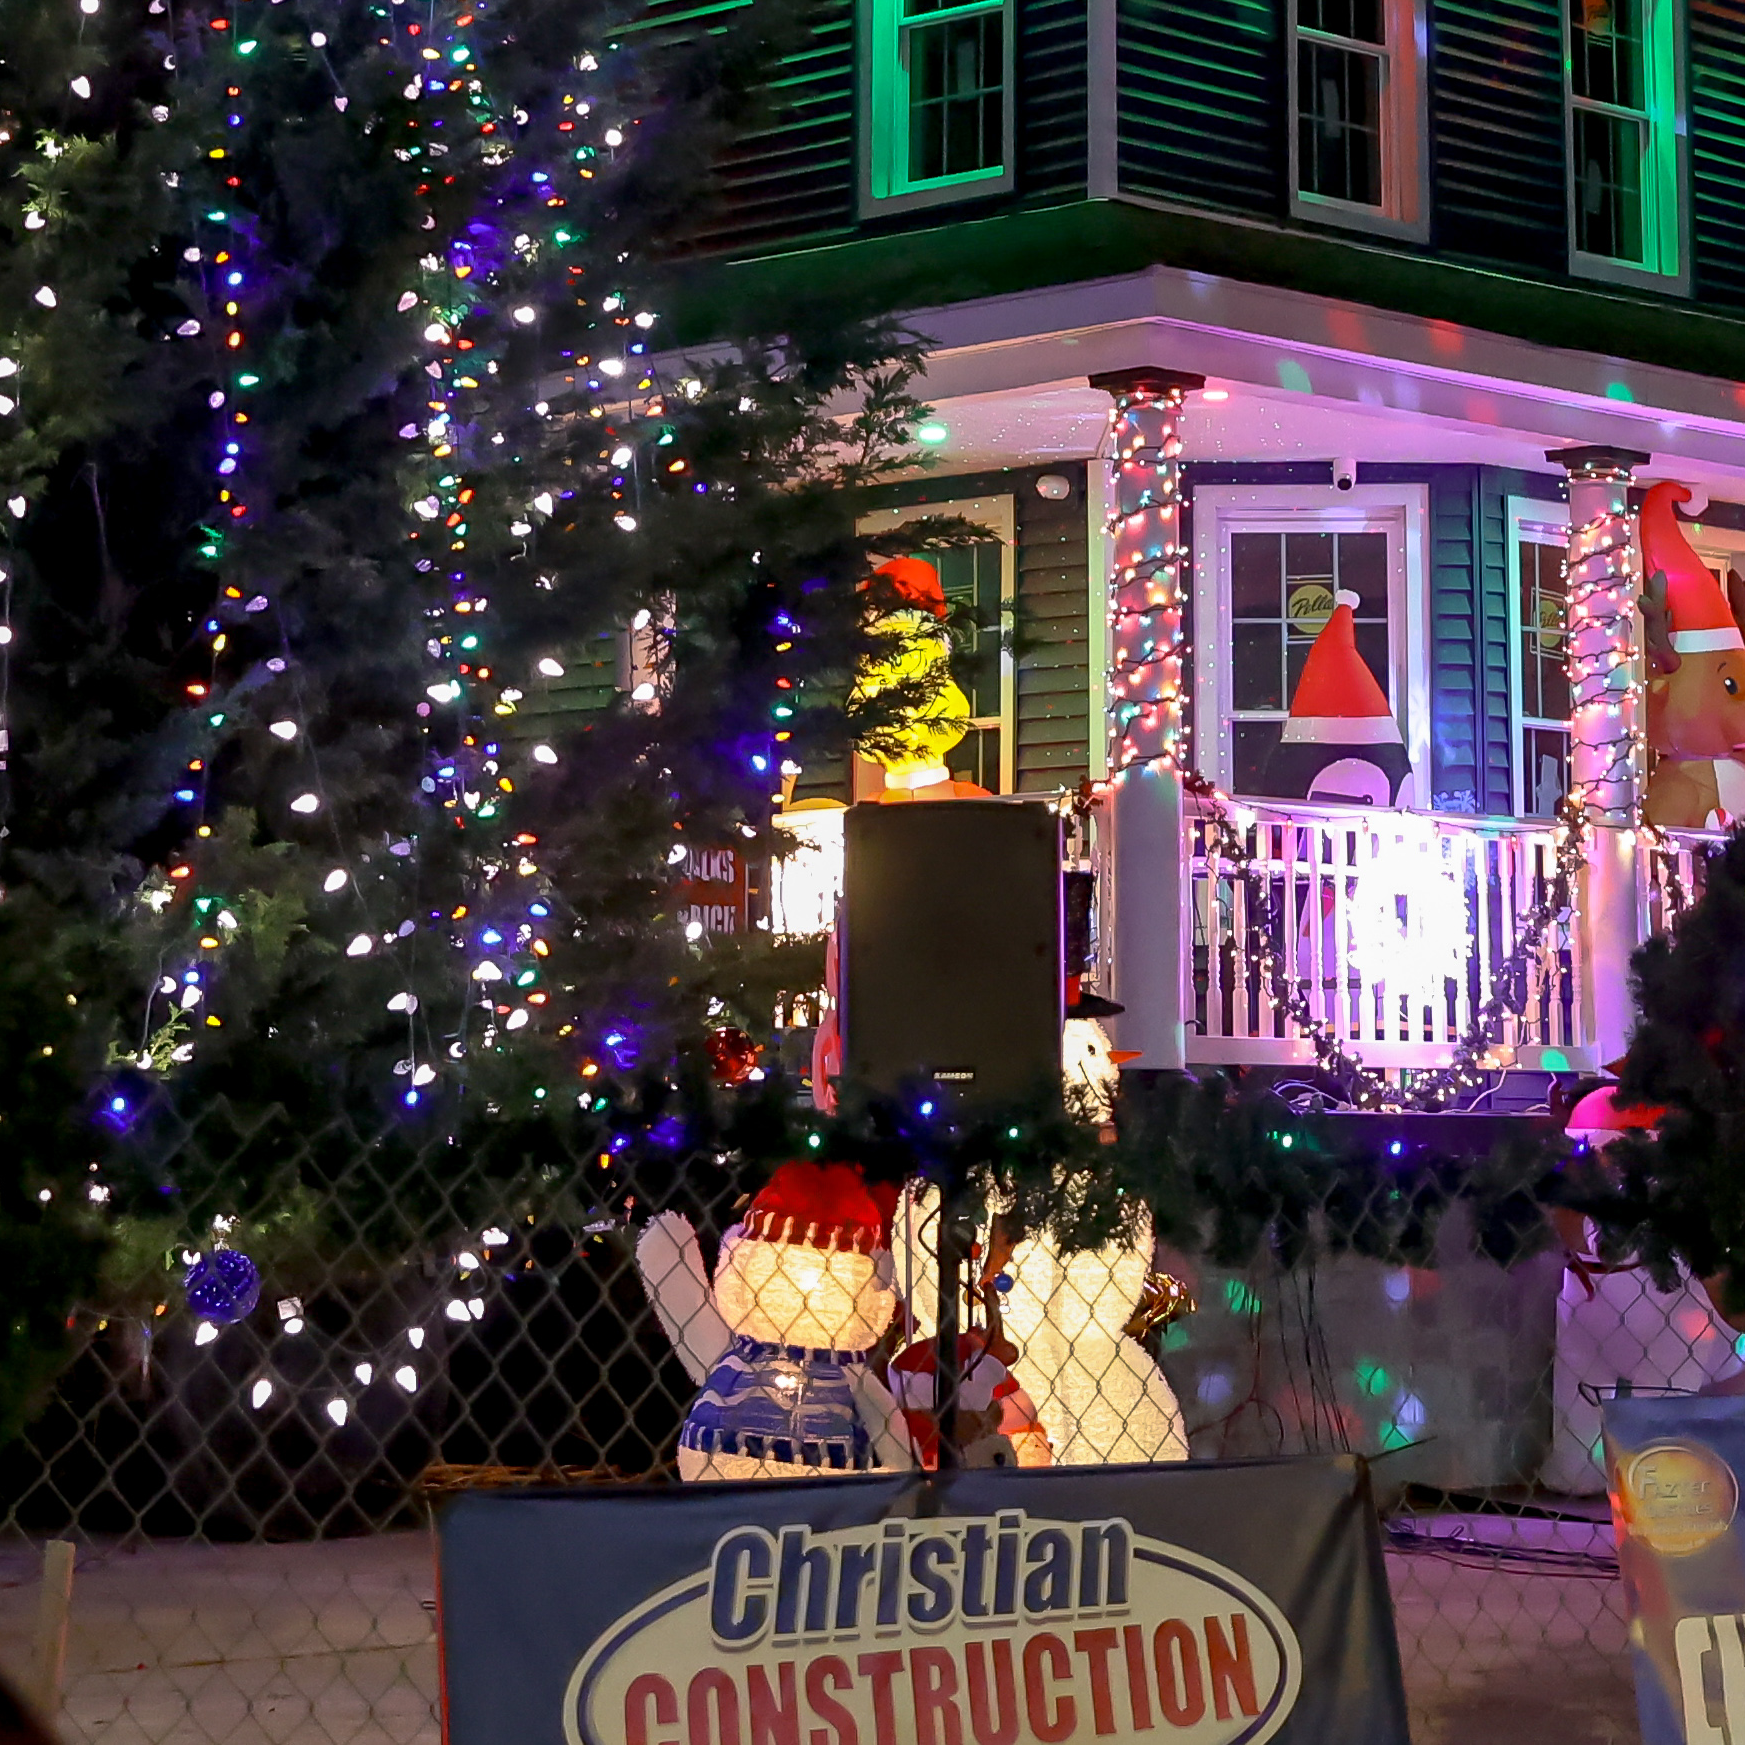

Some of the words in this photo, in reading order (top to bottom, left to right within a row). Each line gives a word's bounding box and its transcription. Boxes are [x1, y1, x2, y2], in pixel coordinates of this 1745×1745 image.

[1292, 594, 1334, 618] Pella
[710, 1512, 1133, 1645] Christian
[623, 1611, 1262, 1745] CONSTRUCTION
